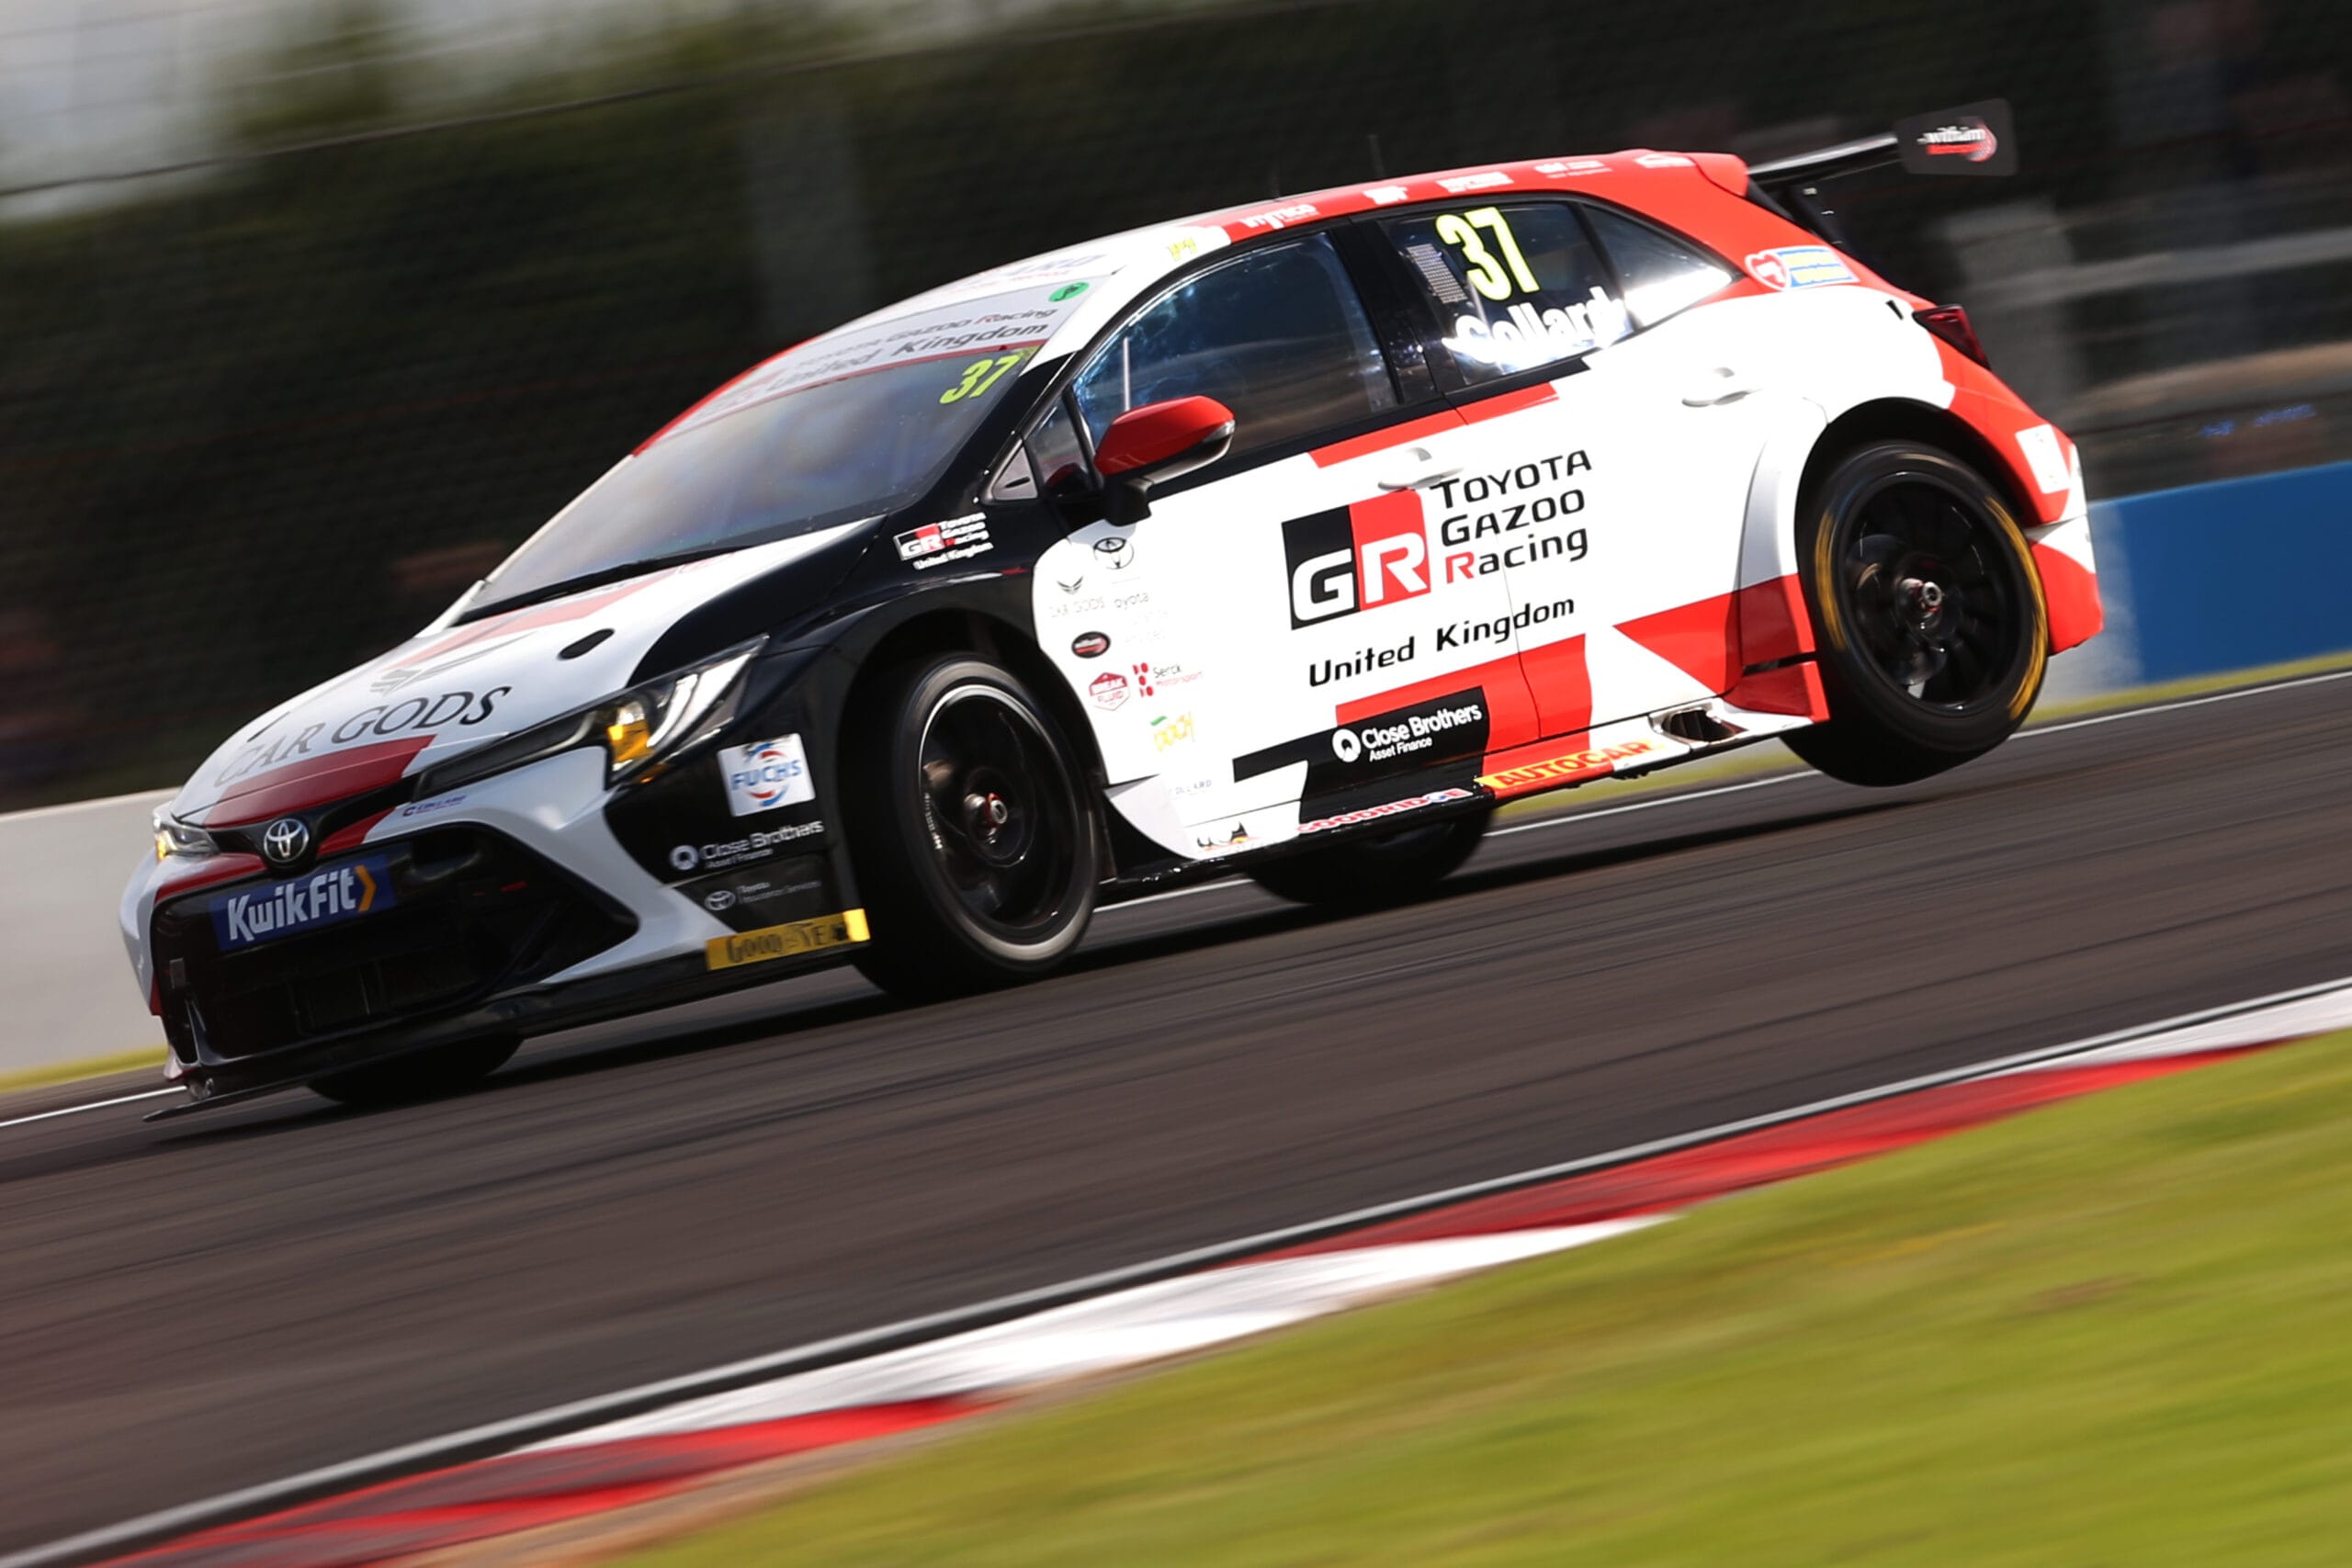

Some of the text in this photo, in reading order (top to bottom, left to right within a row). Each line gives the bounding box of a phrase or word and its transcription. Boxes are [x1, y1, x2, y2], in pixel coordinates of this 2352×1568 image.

[1436, 207, 1540, 300] 37
[891, 323, 1048, 356] Kingdom
[974, 309, 1057, 327] Racing
[1444, 286, 1623, 364] Collard
[939, 355, 1021, 404] 37
[1430, 450, 1592, 508] TOYOTA
[1441, 489, 1586, 547] GAZOO
[900, 535, 944, 558] GR
[1445, 529, 1589, 584] Racing
[1292, 532, 1428, 622] GR
[1109, 592, 1149, 610] oyota
[1308, 599, 1575, 687] United Kingdom
[213, 686, 512, 787] CAR GODS
[1361, 705, 1483, 750] Close Brothers
[1369, 737, 1433, 762] Asset Finance
[731, 759, 802, 790] FUCHS
[1494, 740, 1653, 786] AUTOCAR
[700, 820, 824, 861] Close Brothers
